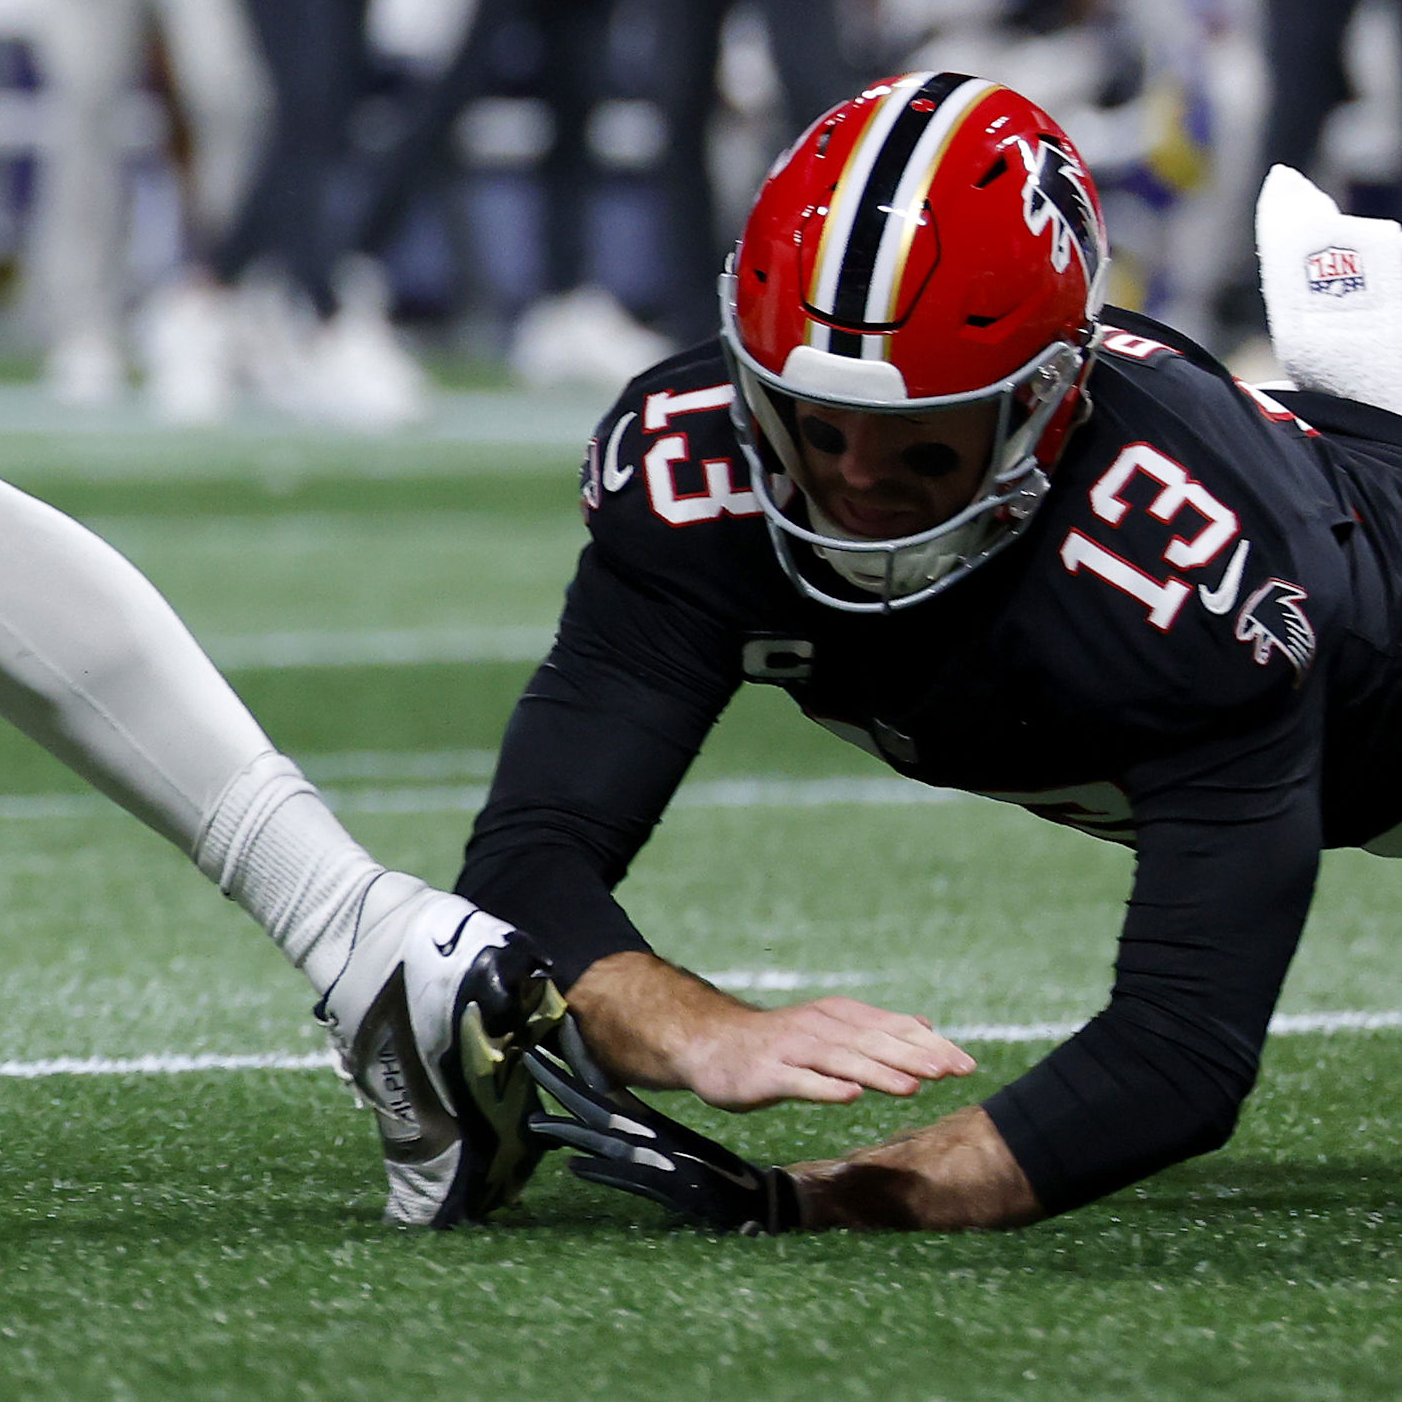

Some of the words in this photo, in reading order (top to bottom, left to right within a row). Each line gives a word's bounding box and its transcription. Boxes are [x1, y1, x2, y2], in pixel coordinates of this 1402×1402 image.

[1306, 251, 1360, 279] NFL
[642, 382, 767, 529] 13
[1057, 440, 1243, 634] 13
[741, 639, 815, 679] C
